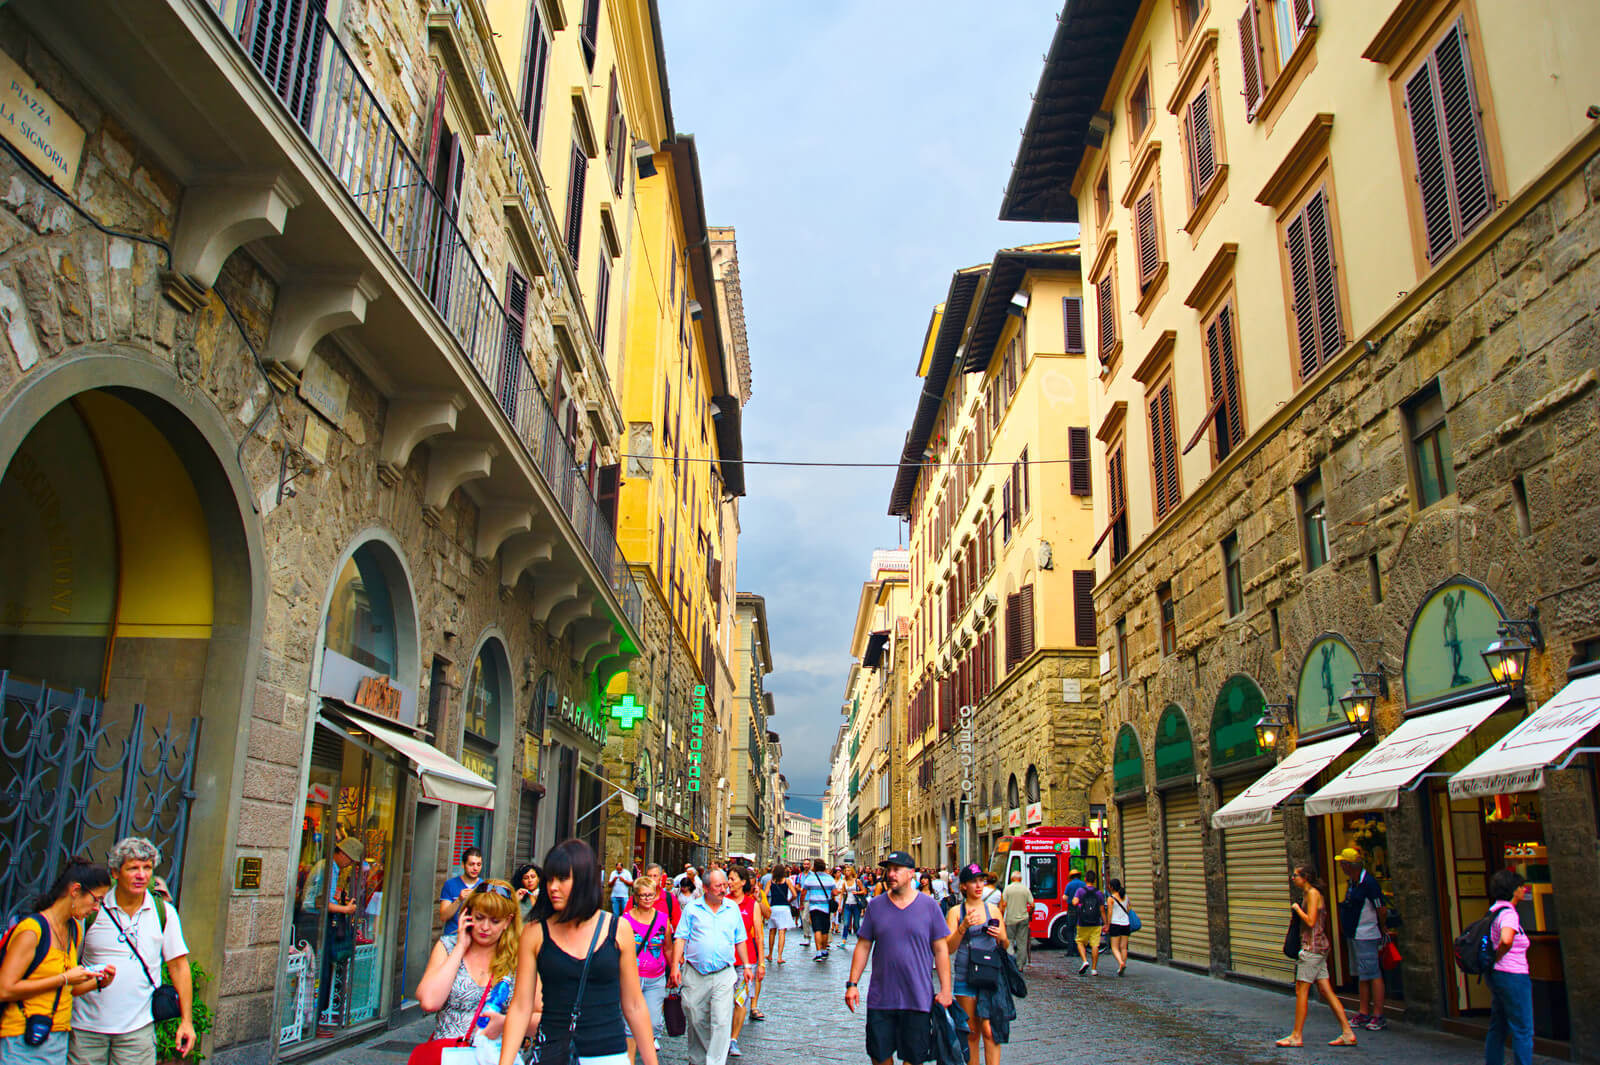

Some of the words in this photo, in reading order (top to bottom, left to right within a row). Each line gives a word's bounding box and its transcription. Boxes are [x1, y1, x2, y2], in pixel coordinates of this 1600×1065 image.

[10, 80, 52, 127] PIAZZA
[20, 121, 69, 175] SIGNORIA
[561, 695, 608, 747] FARMACIA
